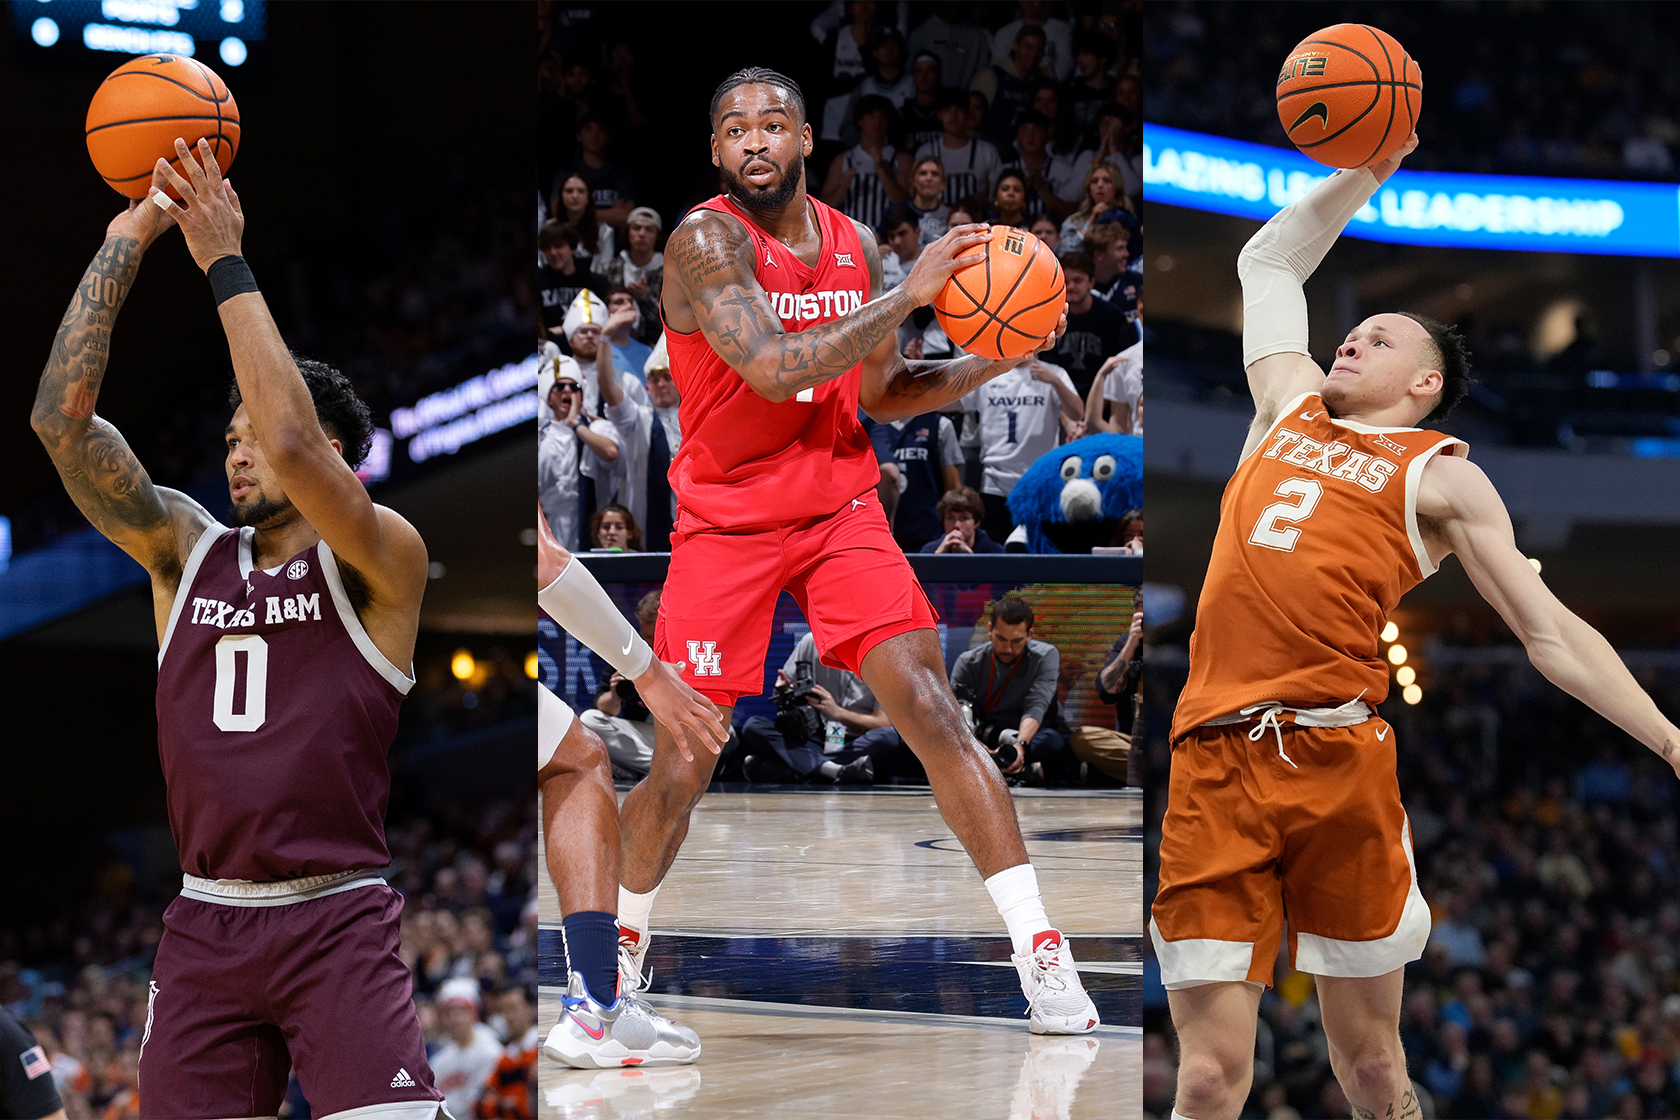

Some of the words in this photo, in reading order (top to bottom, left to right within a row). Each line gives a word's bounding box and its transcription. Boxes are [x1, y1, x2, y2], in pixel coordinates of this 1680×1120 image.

[1277, 57, 1328, 87] ELITE
[1381, 188, 1624, 237] LEADERSHIP
[766, 290, 863, 321] HOUSTON
[988, 396, 1045, 406] XAVIER
[1007, 412, 1017, 443] 1
[1263, 427, 1399, 494] TEXAS
[1248, 476, 1324, 553] 2
[289, 562, 307, 579] SEC
[191, 597, 256, 629] TEXAS
[265, 593, 322, 624] A&M
[687, 640, 722, 676] UH
[213, 634, 268, 732] 0
[390, 1080, 416, 1088] adidas
